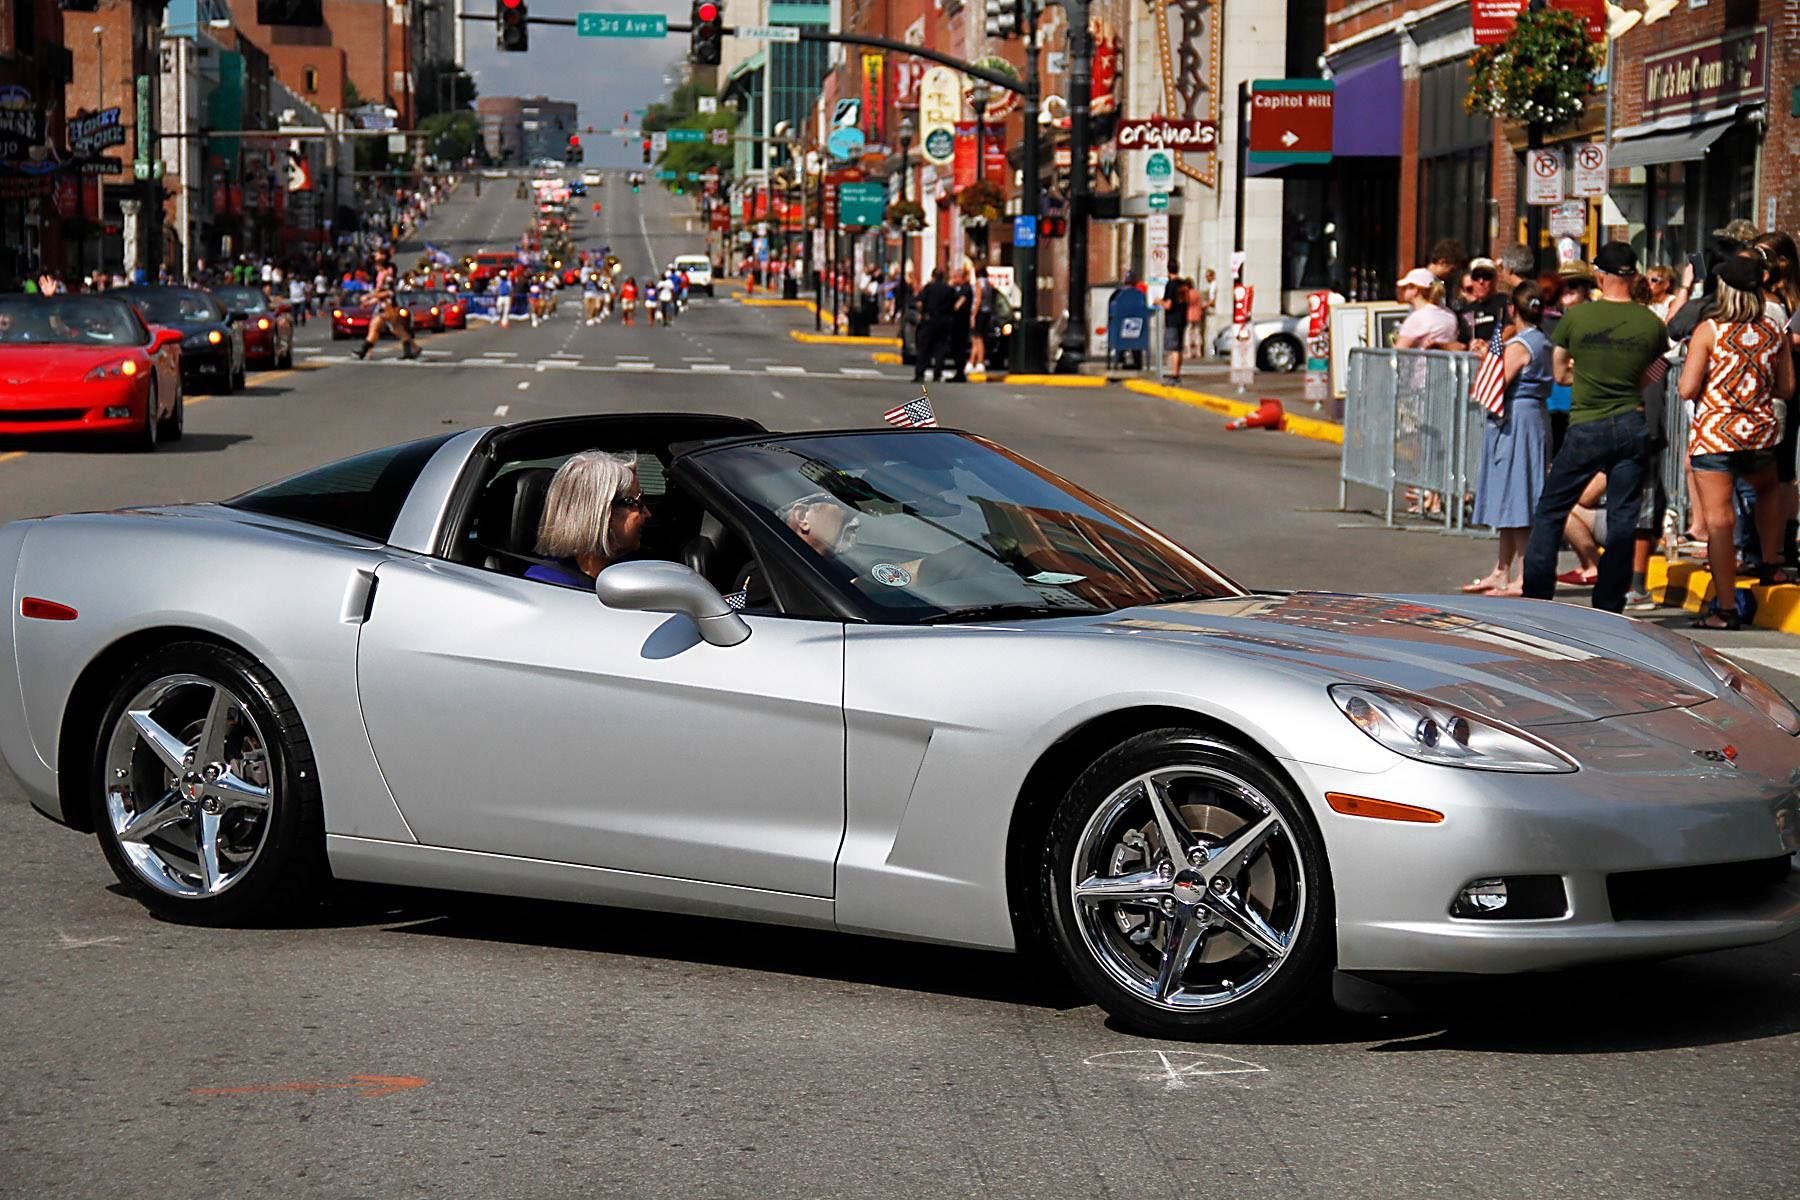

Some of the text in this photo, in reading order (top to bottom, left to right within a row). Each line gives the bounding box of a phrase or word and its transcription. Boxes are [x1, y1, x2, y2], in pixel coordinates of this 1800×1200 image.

[1255, 94, 1331, 109] Capitol Hill
[1120, 121, 1215, 151] originals
